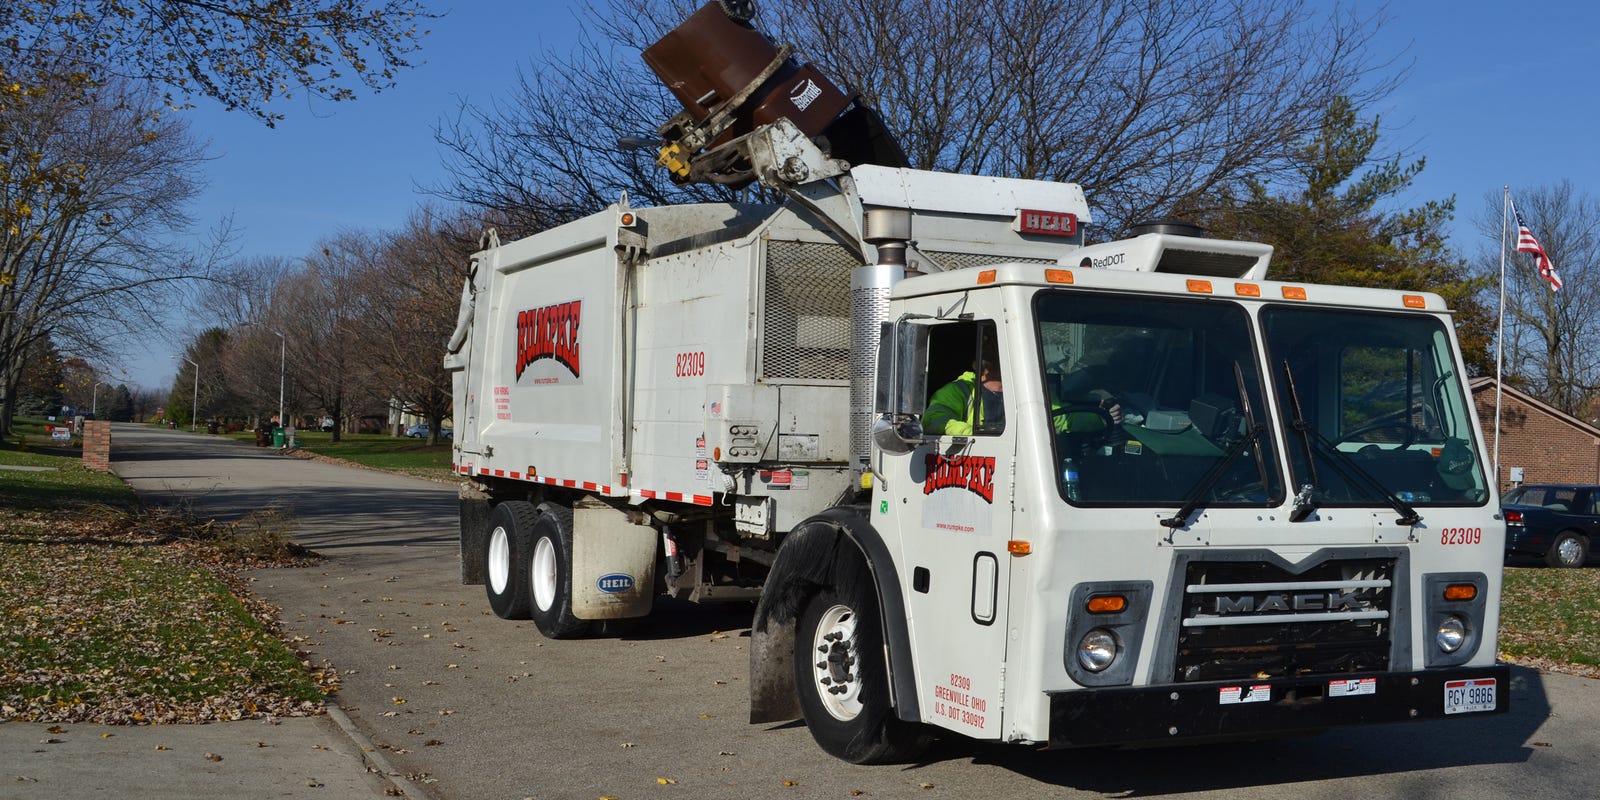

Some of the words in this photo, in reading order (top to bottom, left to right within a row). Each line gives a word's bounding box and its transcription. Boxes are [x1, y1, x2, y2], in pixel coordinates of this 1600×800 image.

[1026, 213, 1071, 232] HEIL
[1093, 253, 1125, 268] RedDOT
[516, 299, 581, 383] RUMPKE
[676, 351, 705, 377] 82309
[923, 453, 995, 504] RUMPKE
[1441, 527, 1481, 545] 82309
[602, 579, 630, 588] HEIL
[1215, 591, 1366, 613] MACK
[950, 673, 971, 691] 82309
[935, 685, 969, 707] GREENVILLE
[971, 696, 986, 712] OHIO
[1448, 689, 1465, 706] PGY
[1469, 687, 1493, 704] 9886
[935, 701, 947, 716] U.S.
[948, 706, 960, 720] DOT
[962, 710, 985, 729] 330912
